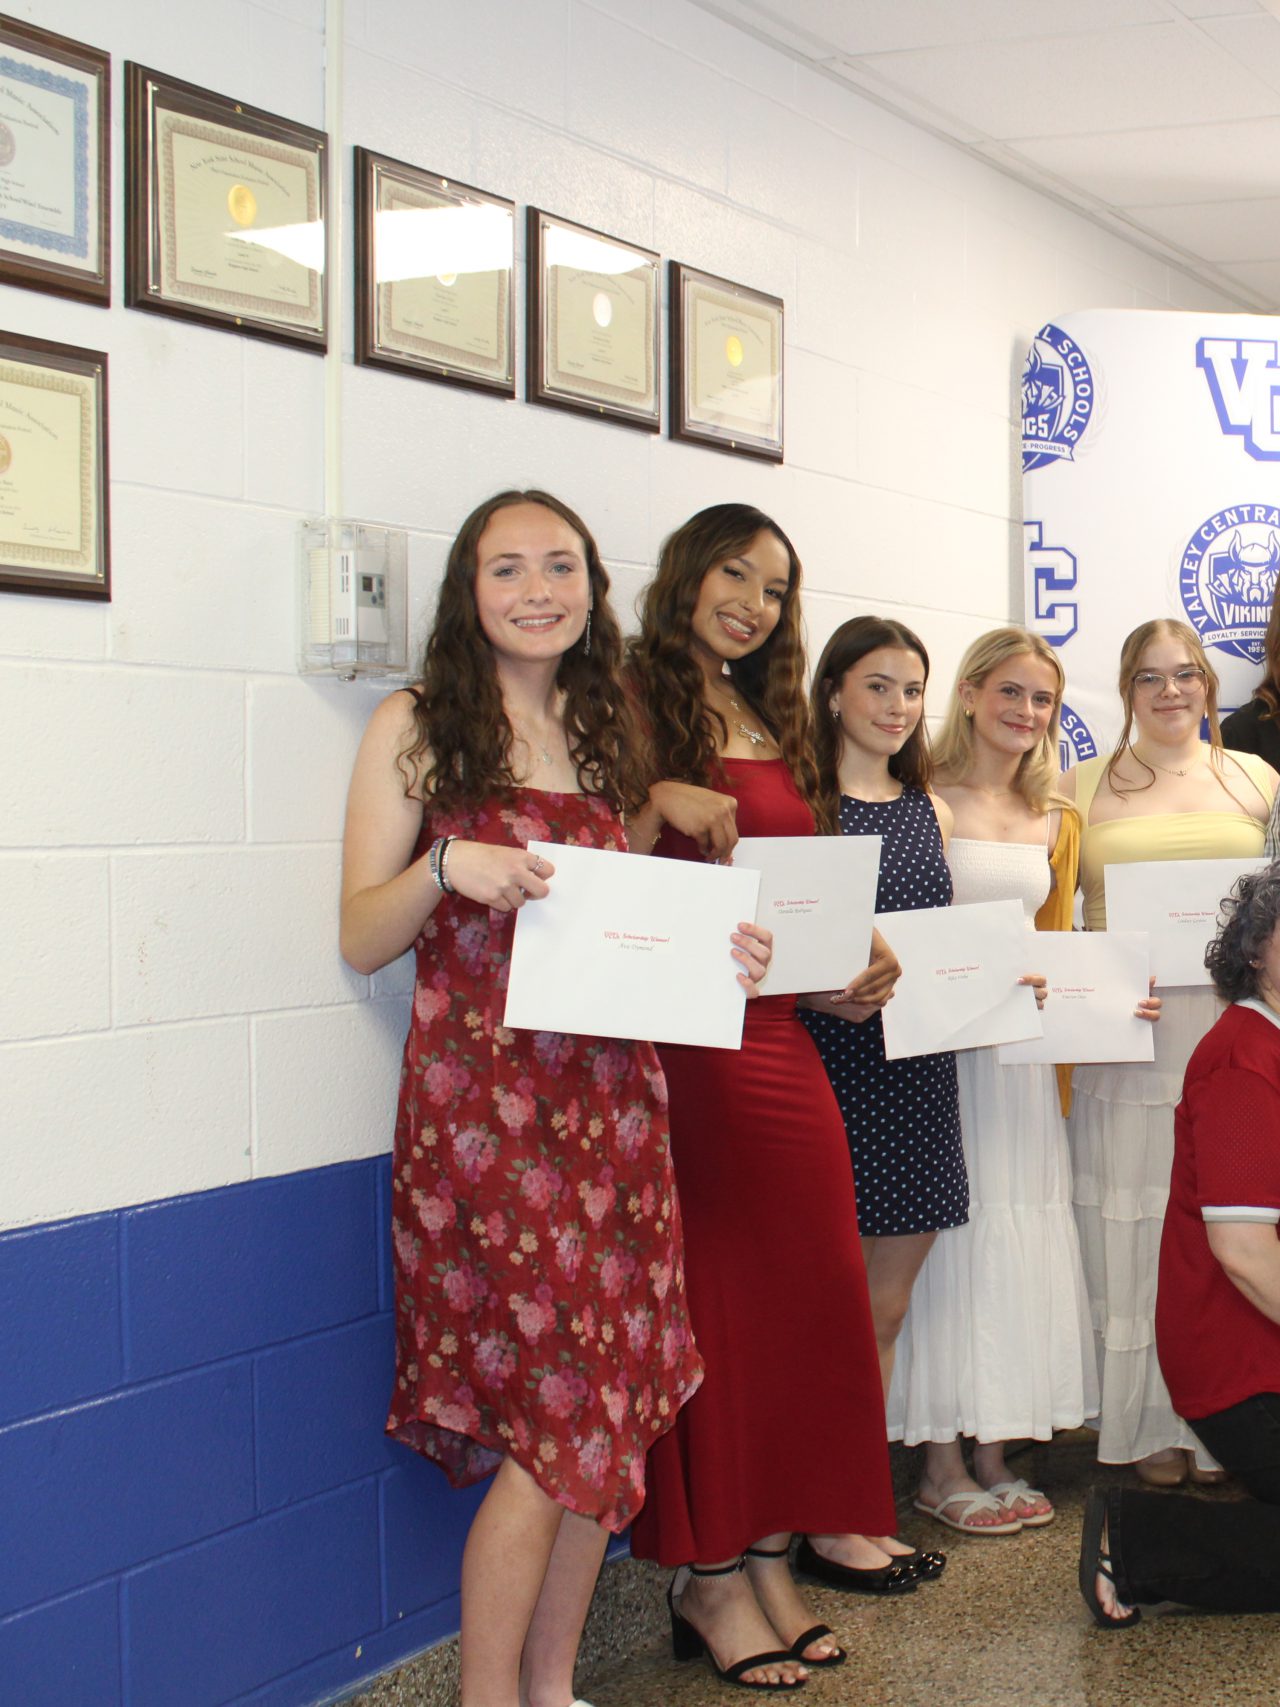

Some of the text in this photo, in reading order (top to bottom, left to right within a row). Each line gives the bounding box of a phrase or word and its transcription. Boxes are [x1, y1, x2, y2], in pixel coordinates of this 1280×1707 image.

[1057, 339, 1091, 442] SCHOOLS
[1031, 443, 1065, 453] PROGRESS
[1182, 544, 1208, 628] VALLEY
[1207, 631, 1237, 640] LOYALTY
